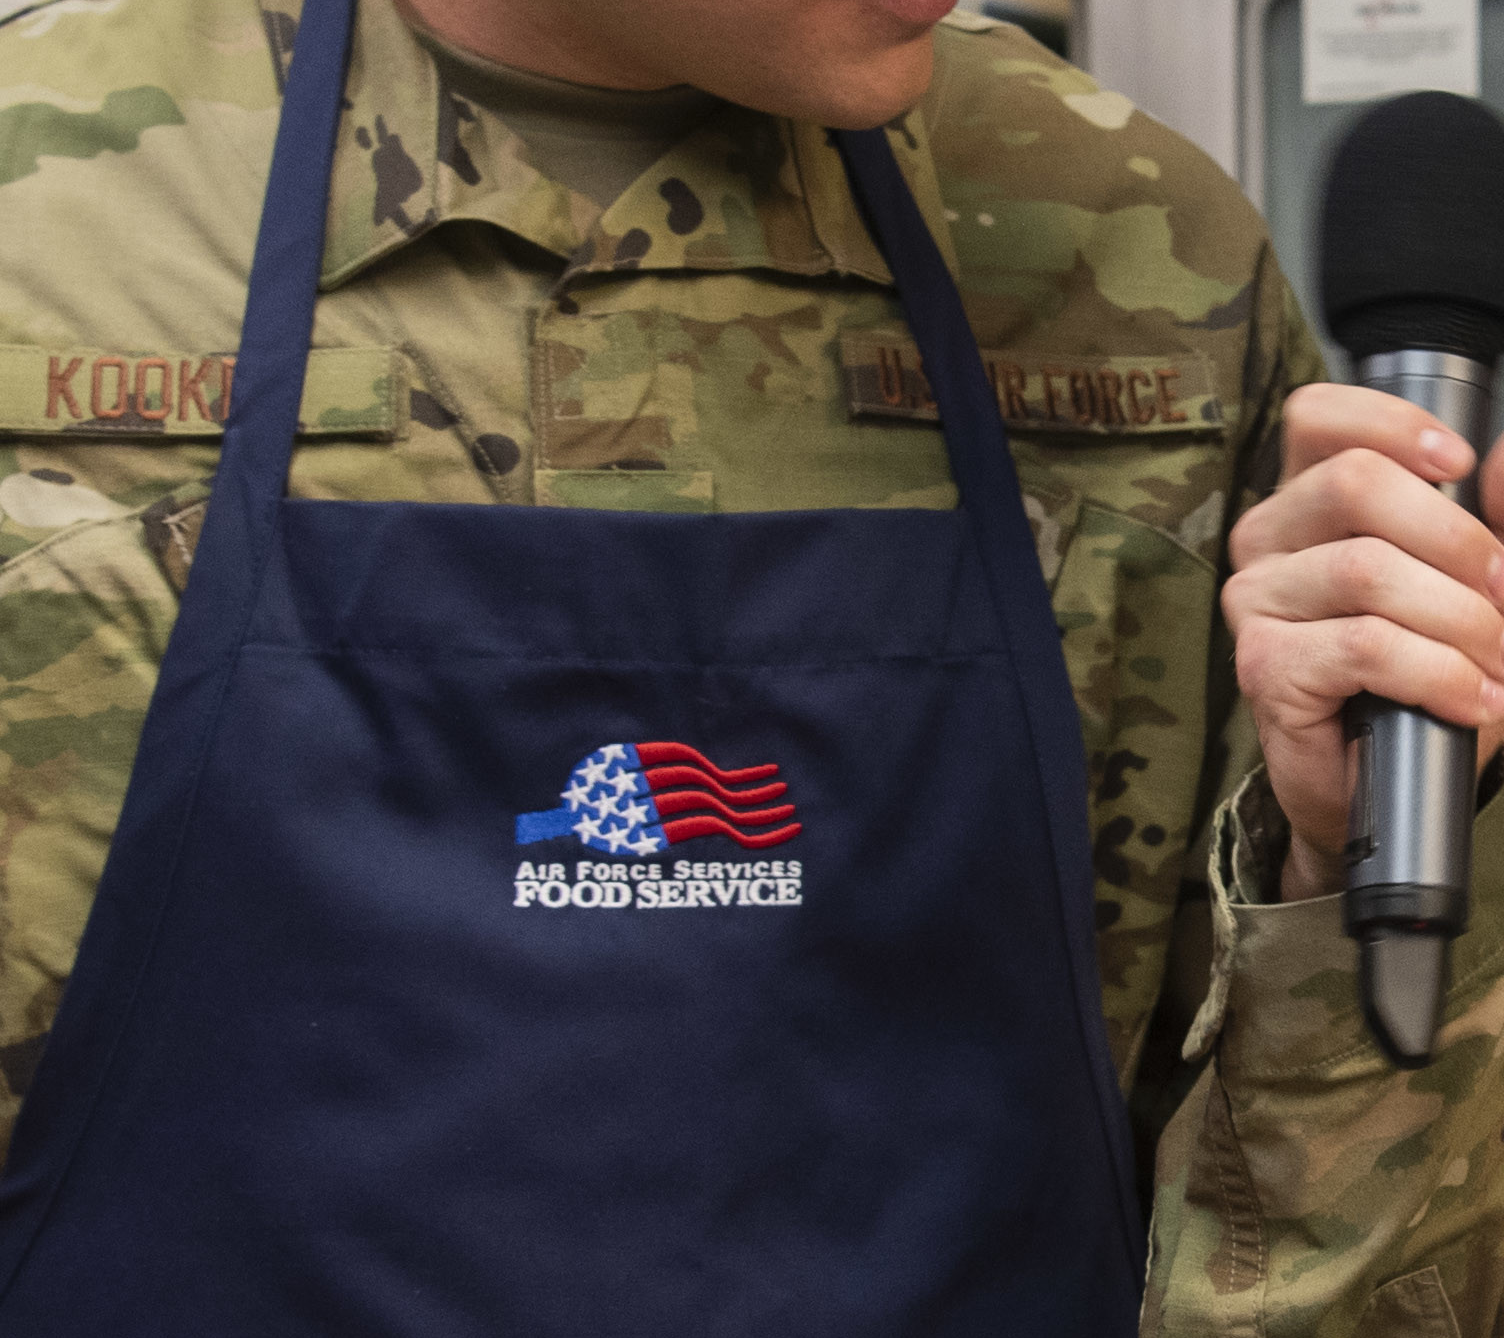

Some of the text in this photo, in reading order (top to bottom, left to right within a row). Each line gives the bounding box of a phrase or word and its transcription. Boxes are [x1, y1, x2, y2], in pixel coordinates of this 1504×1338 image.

[1044, 367, 1188, 425] FORCE
[576, 861, 663, 881] FORCE
[673, 860, 803, 880] SERVICES
[512, 878, 803, 909] FOOD SERVICE
